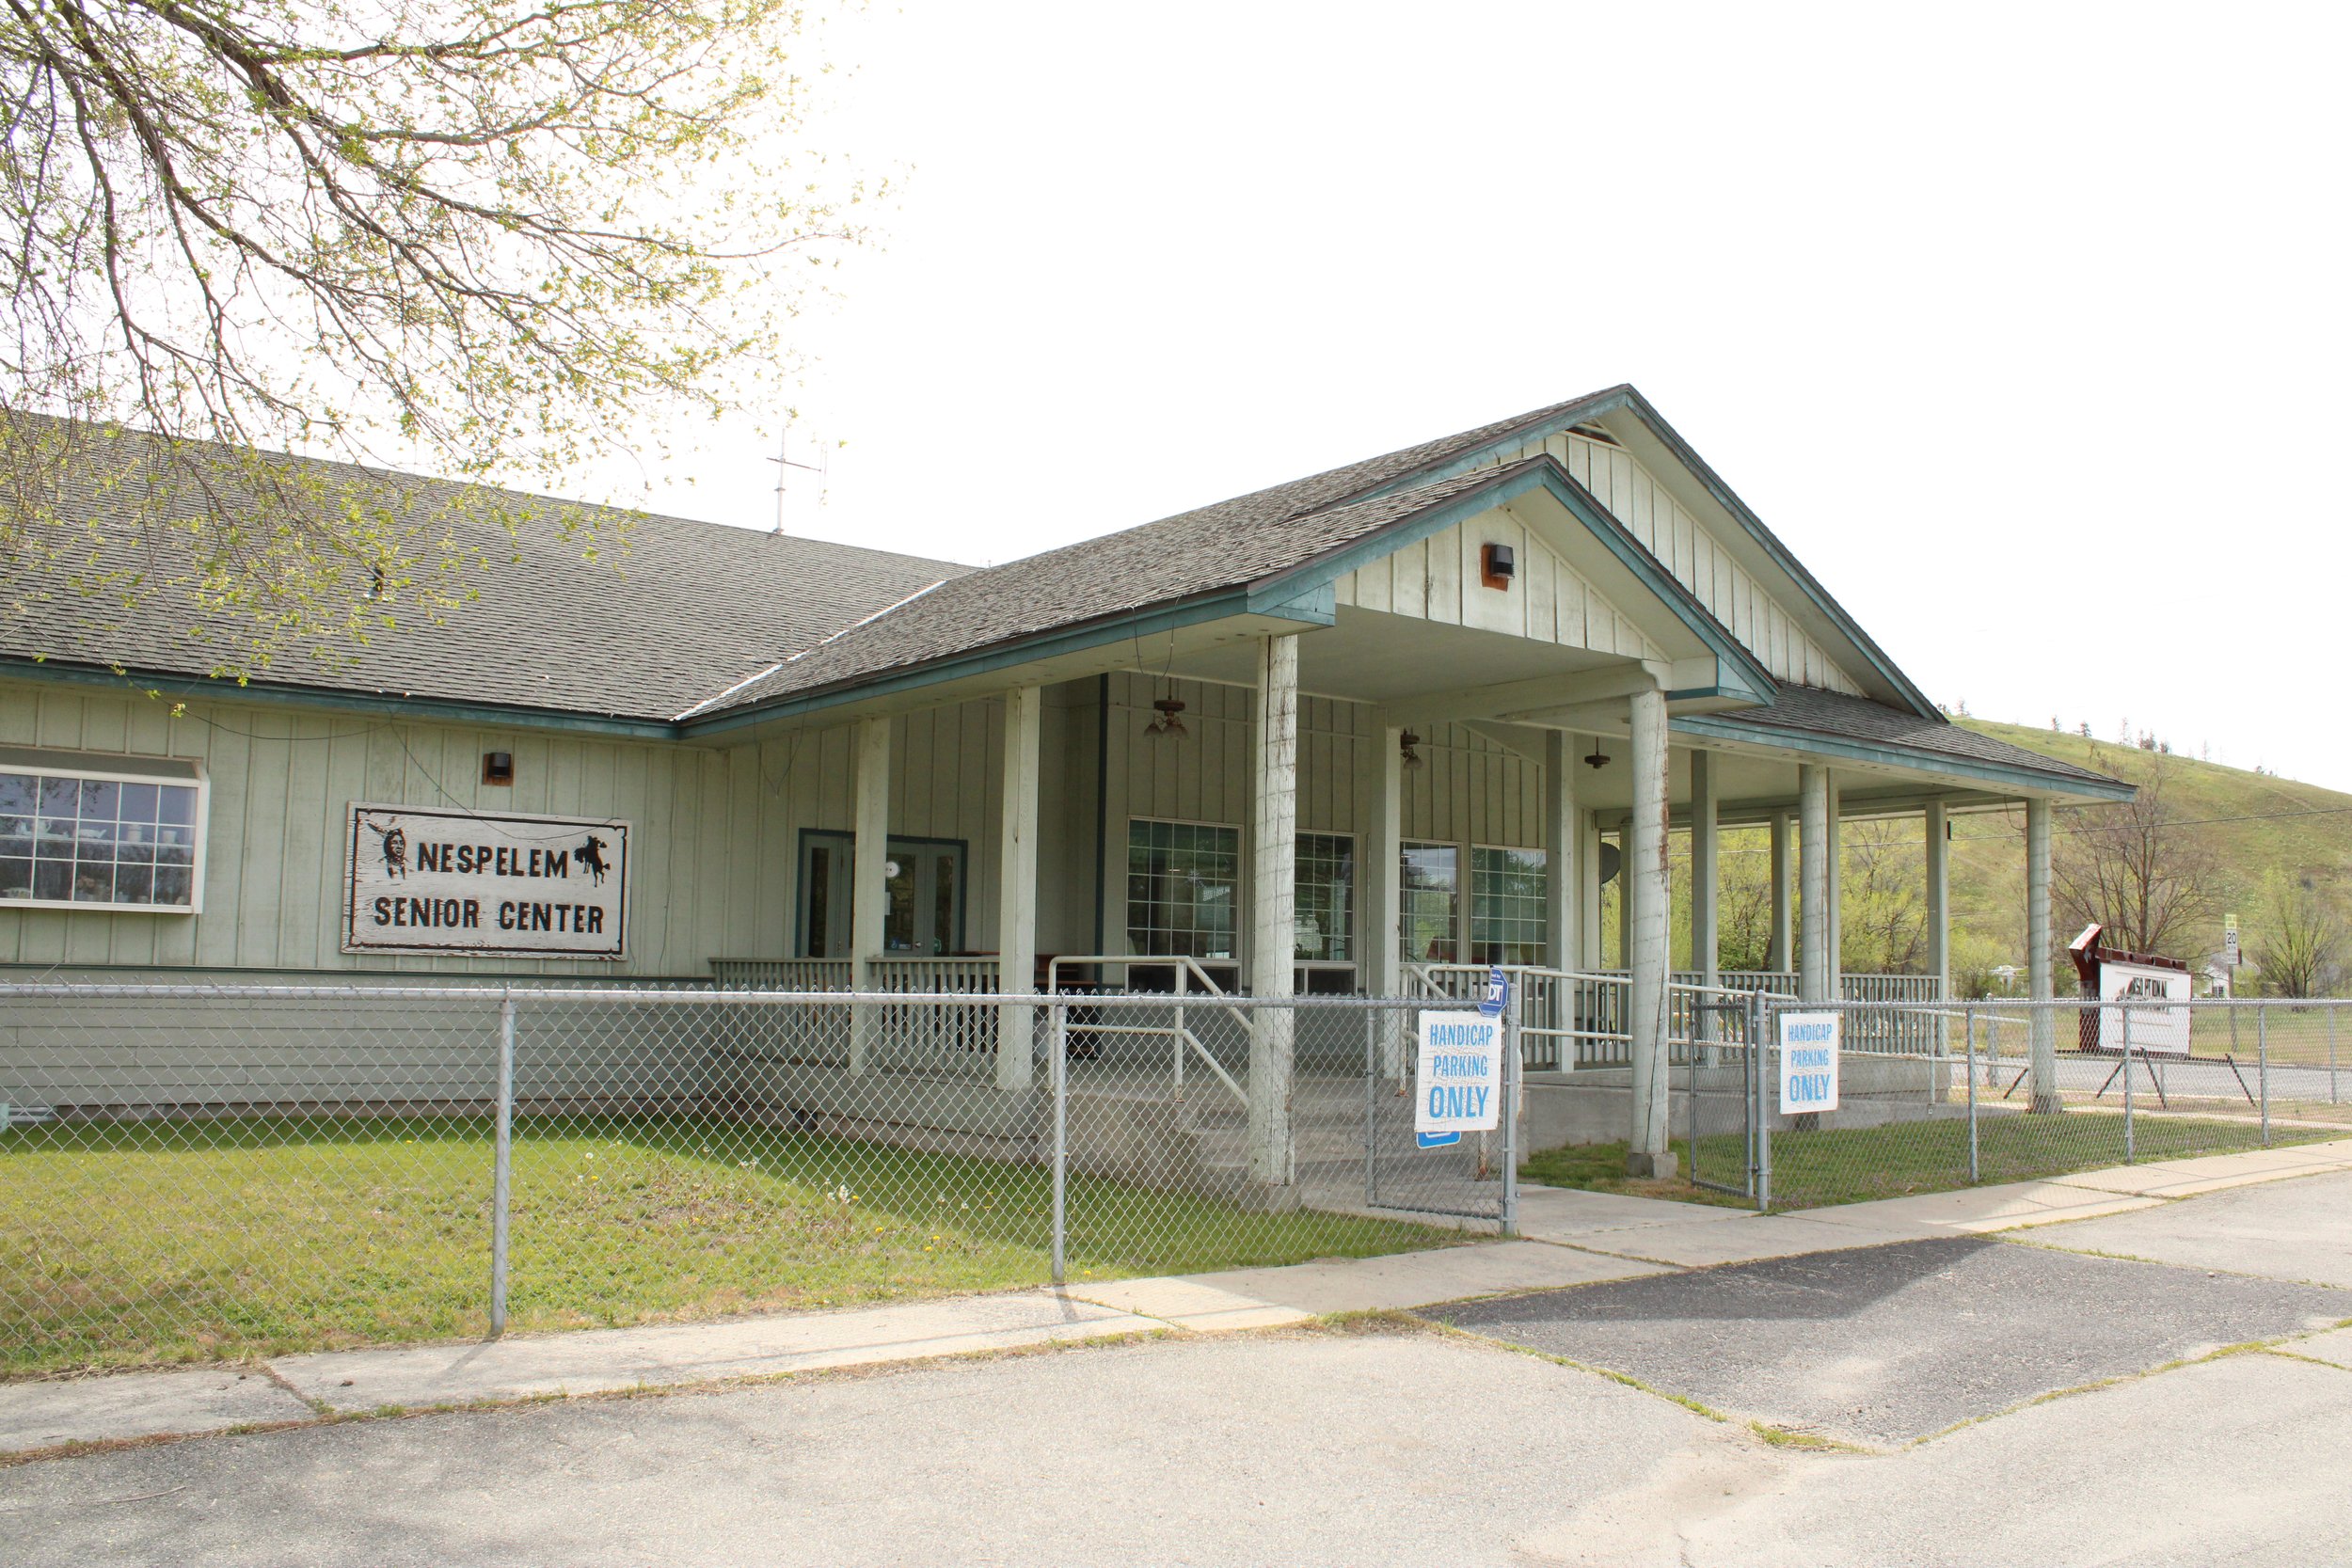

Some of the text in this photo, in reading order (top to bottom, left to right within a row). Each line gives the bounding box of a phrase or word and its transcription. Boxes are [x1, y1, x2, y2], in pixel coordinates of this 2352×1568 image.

[417, 842, 568, 879] NESPELEM
[374, 896, 604, 933] SENIOR CENTER
[2227, 932, 2236, 944] 20
[1488, 983, 1503, 1002] DT
[1429, 1023, 1494, 1046] HANDICAP
[1788, 1022, 1834, 1042] HANDICAP
[1433, 1054, 1488, 1077] PARKING
[1790, 1049, 1830, 1068] PARKING
[1789, 1073, 1831, 1102] ONLY
[1428, 1085, 1490, 1118] ONLY
